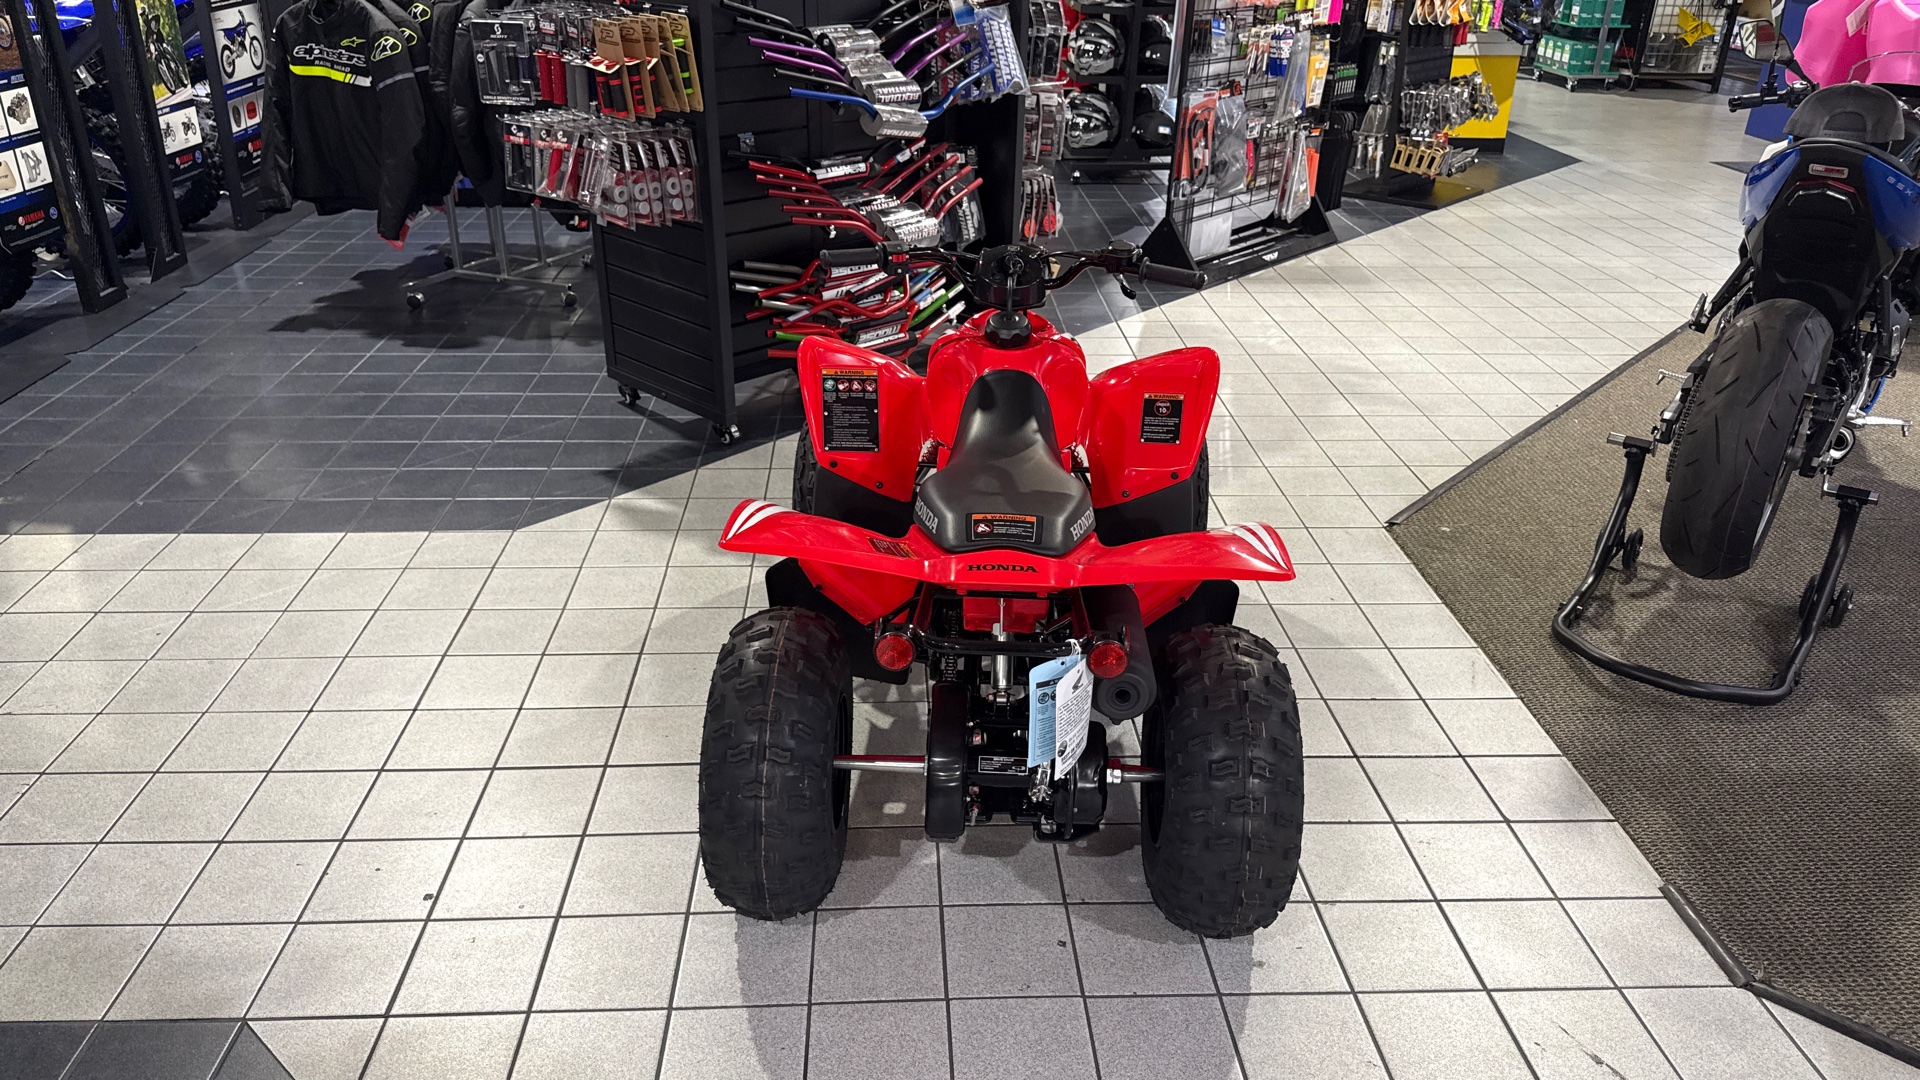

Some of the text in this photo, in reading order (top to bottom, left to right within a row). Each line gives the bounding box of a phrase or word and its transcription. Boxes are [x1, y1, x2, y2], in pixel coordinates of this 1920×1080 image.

[990, 20, 1012, 82] RENTHAL
[876, 84, 921, 95] RENTHAL
[879, 92, 920, 103] RENTHAL
[882, 128, 921, 138] RENTHAL
[1886, 176, 1913, 197] GSX
[903, 228, 938, 242] RENTHAL
[915, 495, 939, 534] HONDA
[1070, 506, 1095, 542] HONDA
[967, 563, 1038, 573] HONDA
